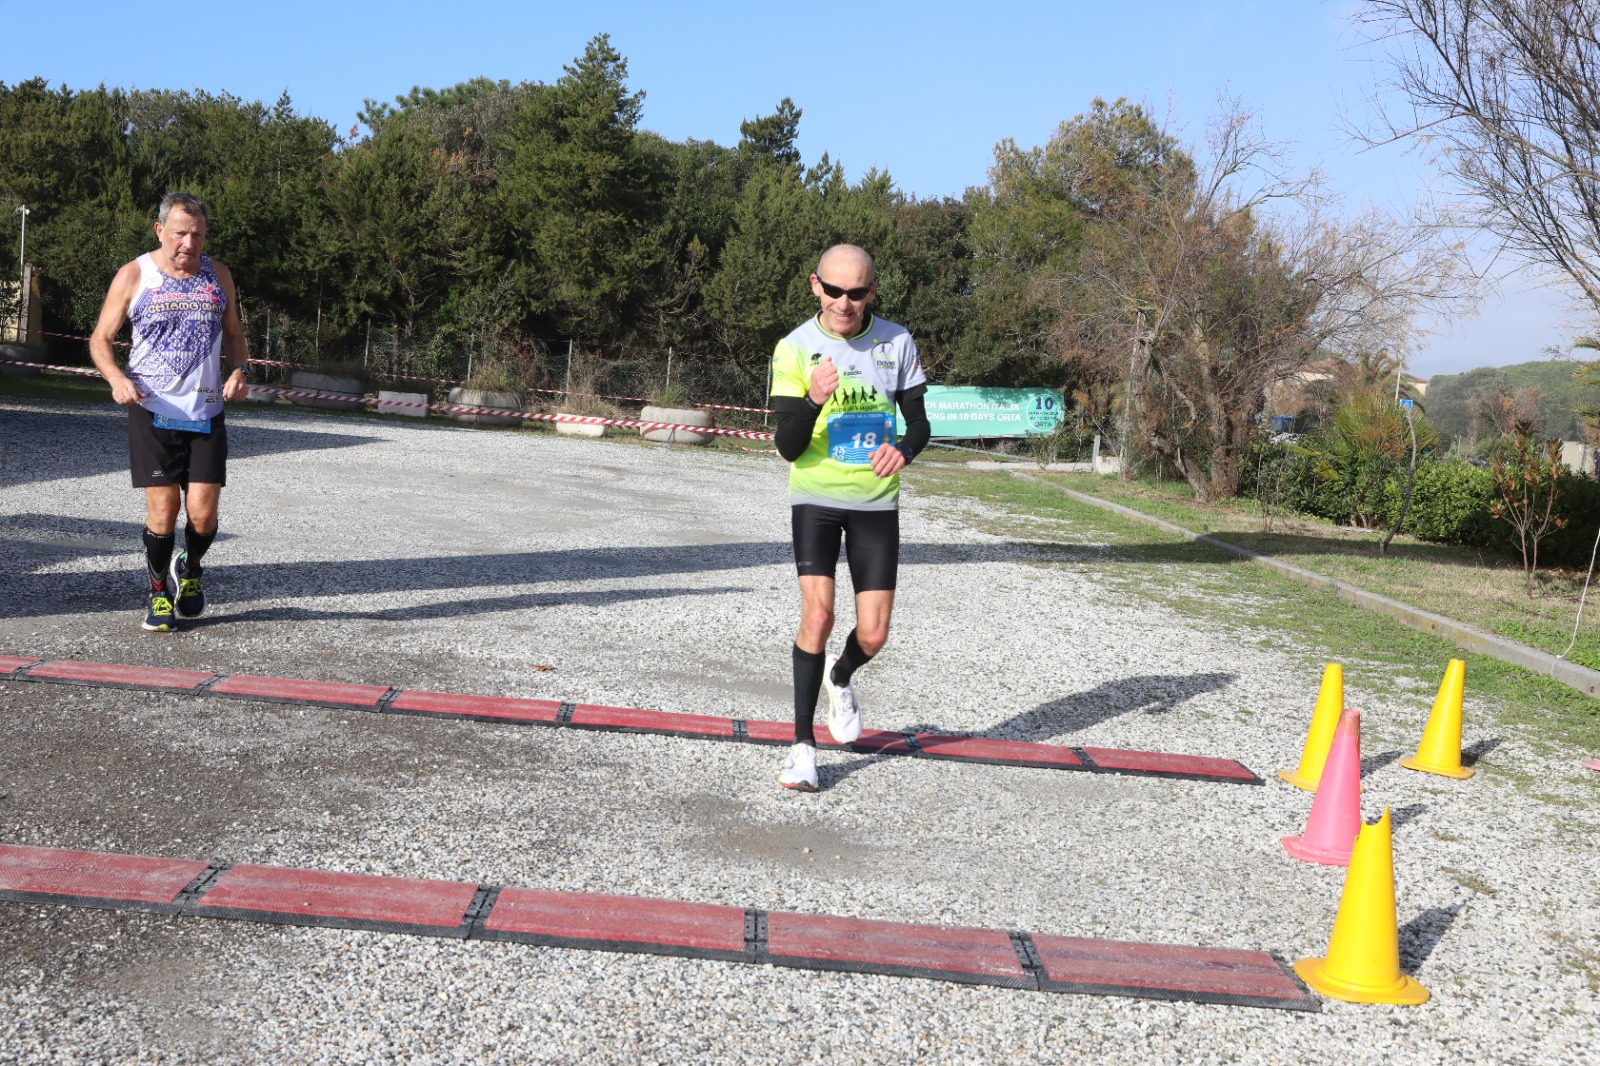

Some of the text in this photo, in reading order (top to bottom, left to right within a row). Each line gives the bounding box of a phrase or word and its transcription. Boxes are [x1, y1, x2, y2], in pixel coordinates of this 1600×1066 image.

[939, 402, 990, 410] MARATHON
[991, 403, 1020, 411] ITALIA
[1035, 397, 1054, 410] 10
[947, 412, 957, 420] IN
[971, 413, 995, 421] DAYS
[996, 413, 1021, 421] ORTA
[851, 432, 877, 449] 18
